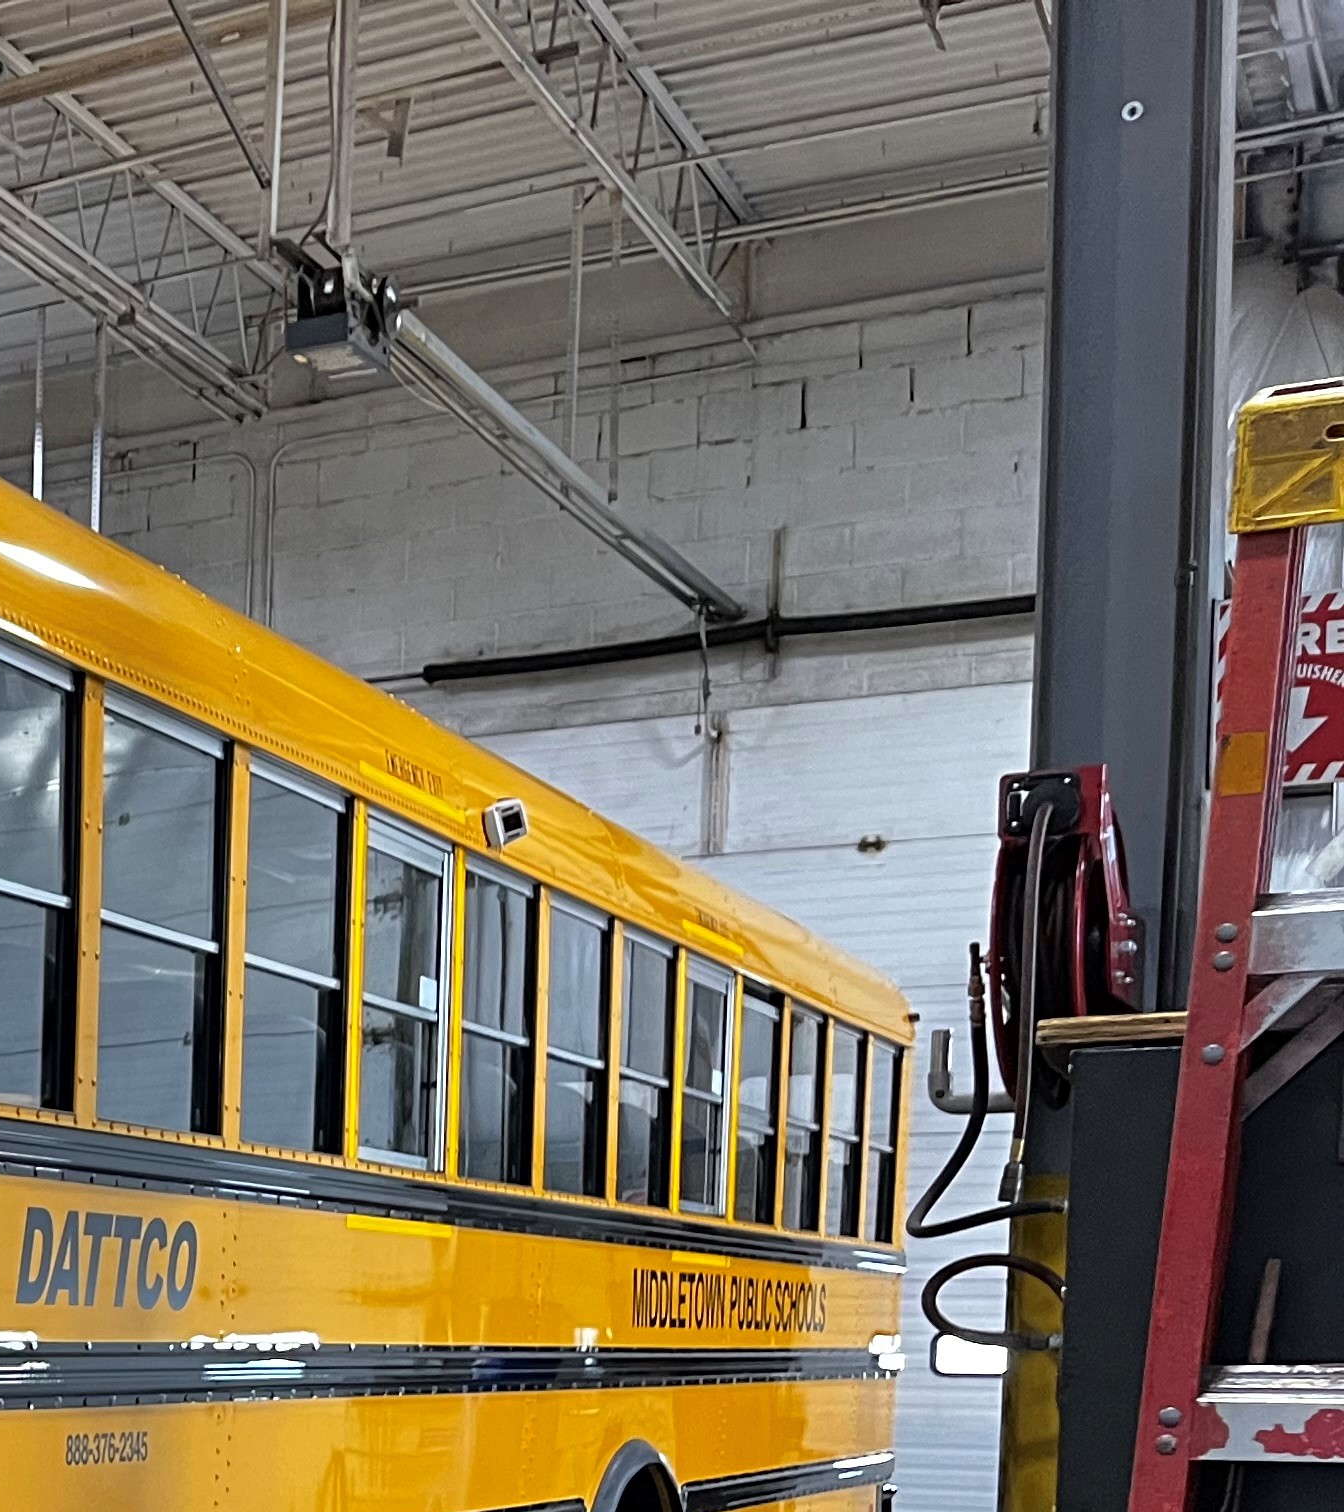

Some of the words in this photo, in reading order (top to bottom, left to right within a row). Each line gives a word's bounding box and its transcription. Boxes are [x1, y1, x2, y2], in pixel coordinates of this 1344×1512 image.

[1296, 619, 1344, 656] RE
[15, 1206, 198, 1311] DATTCO
[631, 1267, 727, 1330] MIDDLETOWN
[729, 1275, 774, 1331] PUBLIC
[774, 1280, 827, 1333] SCHOOLS
[65, 1430, 149, 1466] 888-376-2345
